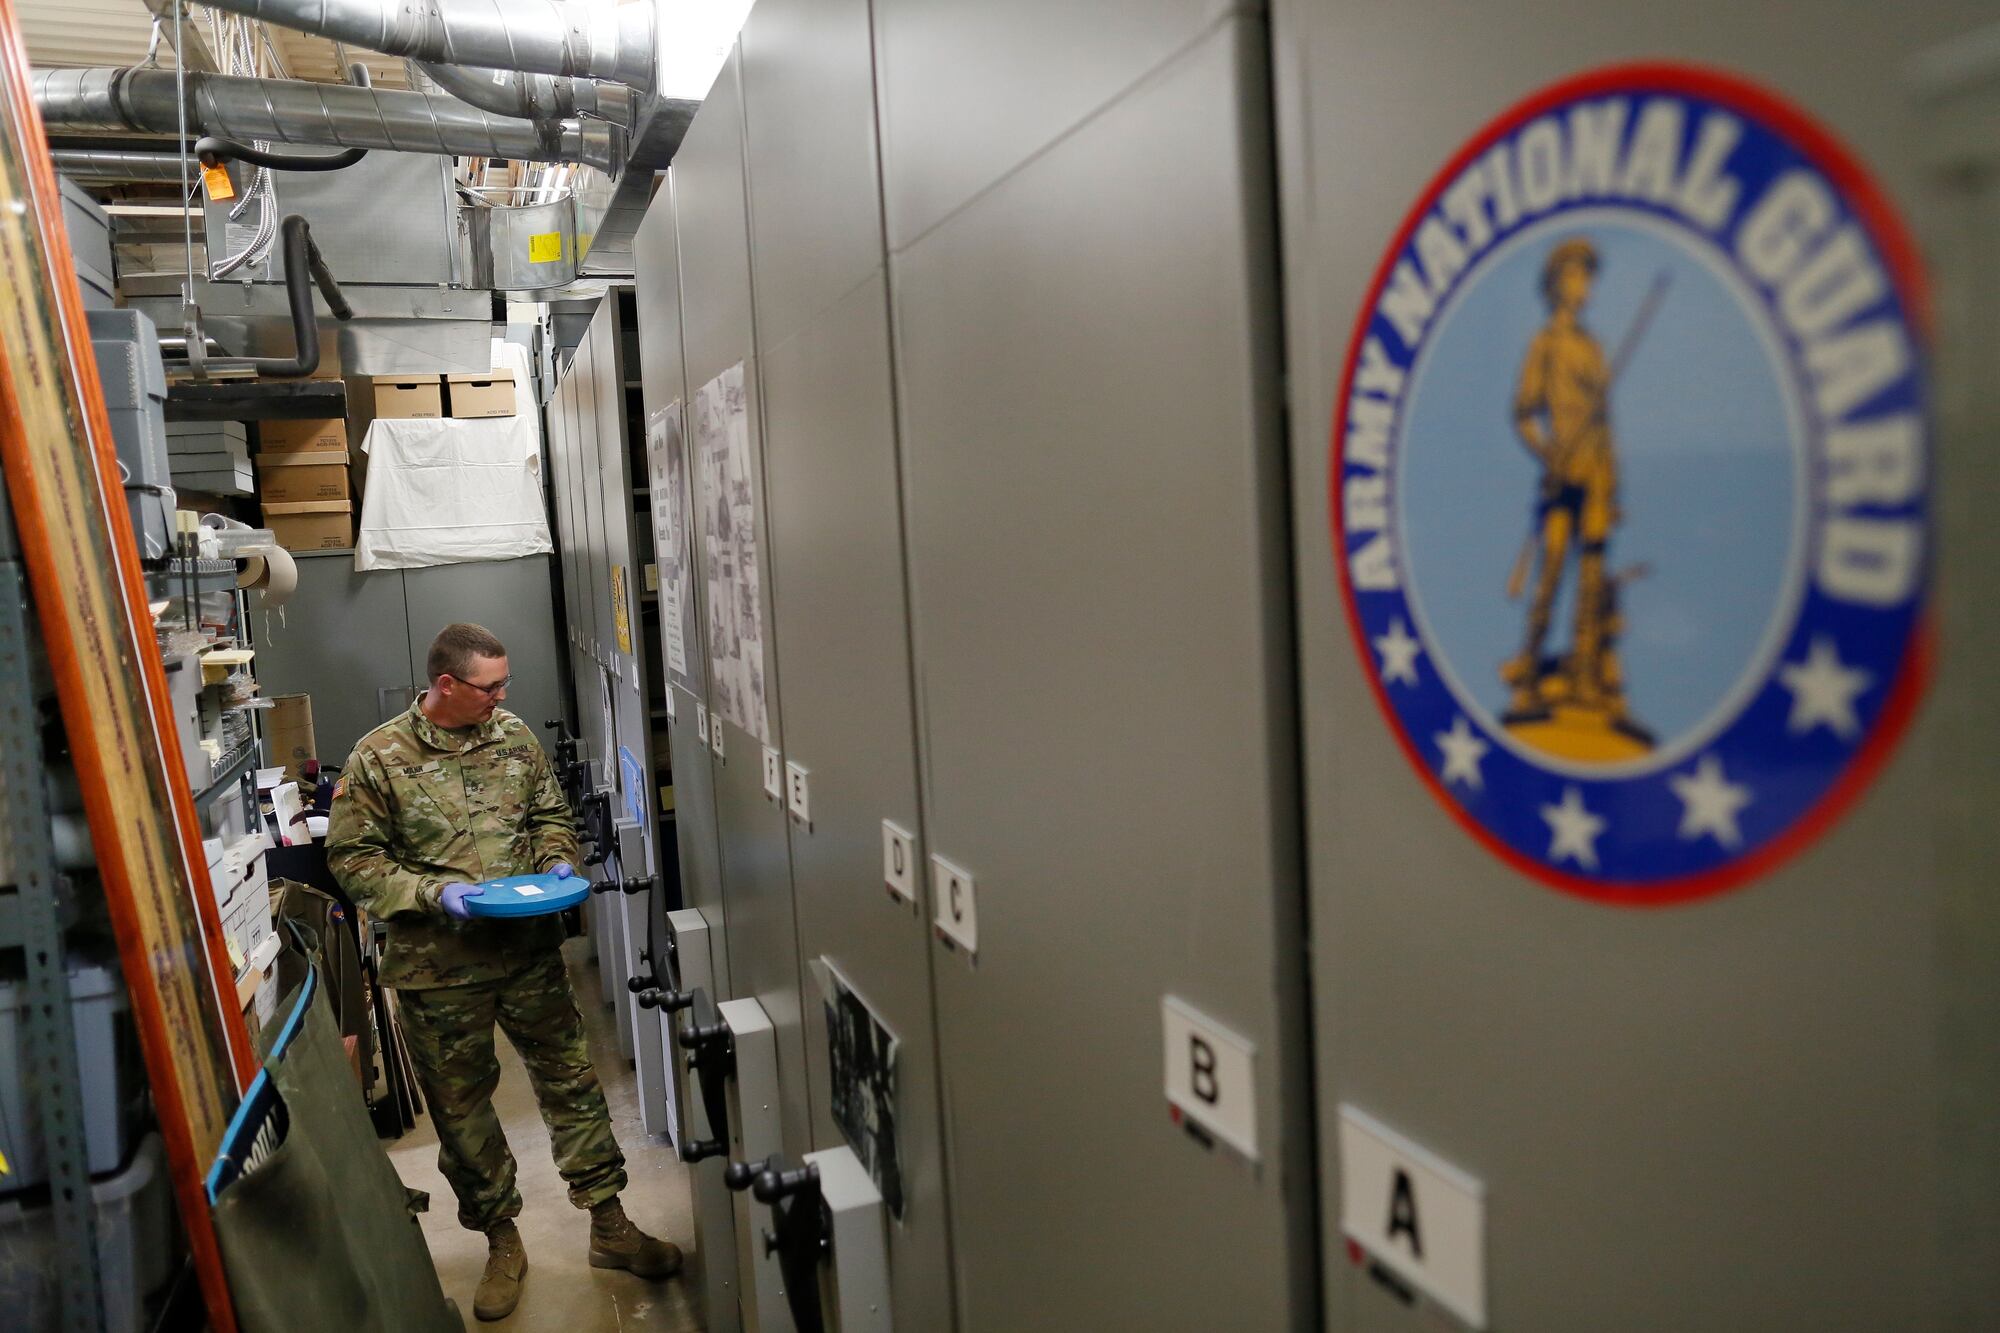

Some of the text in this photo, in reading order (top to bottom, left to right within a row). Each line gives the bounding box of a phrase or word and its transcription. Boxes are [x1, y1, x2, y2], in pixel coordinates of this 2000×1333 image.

[1341, 95, 1925, 607] ARMY NATIONAL GUARD
[508, 743, 528, 755] ARMY
[794, 773, 802, 806] E
[893, 837, 903, 876] D
[951, 877, 961, 923] C
[1189, 1034, 1218, 1106] B
[1387, 1166, 1424, 1260] A
